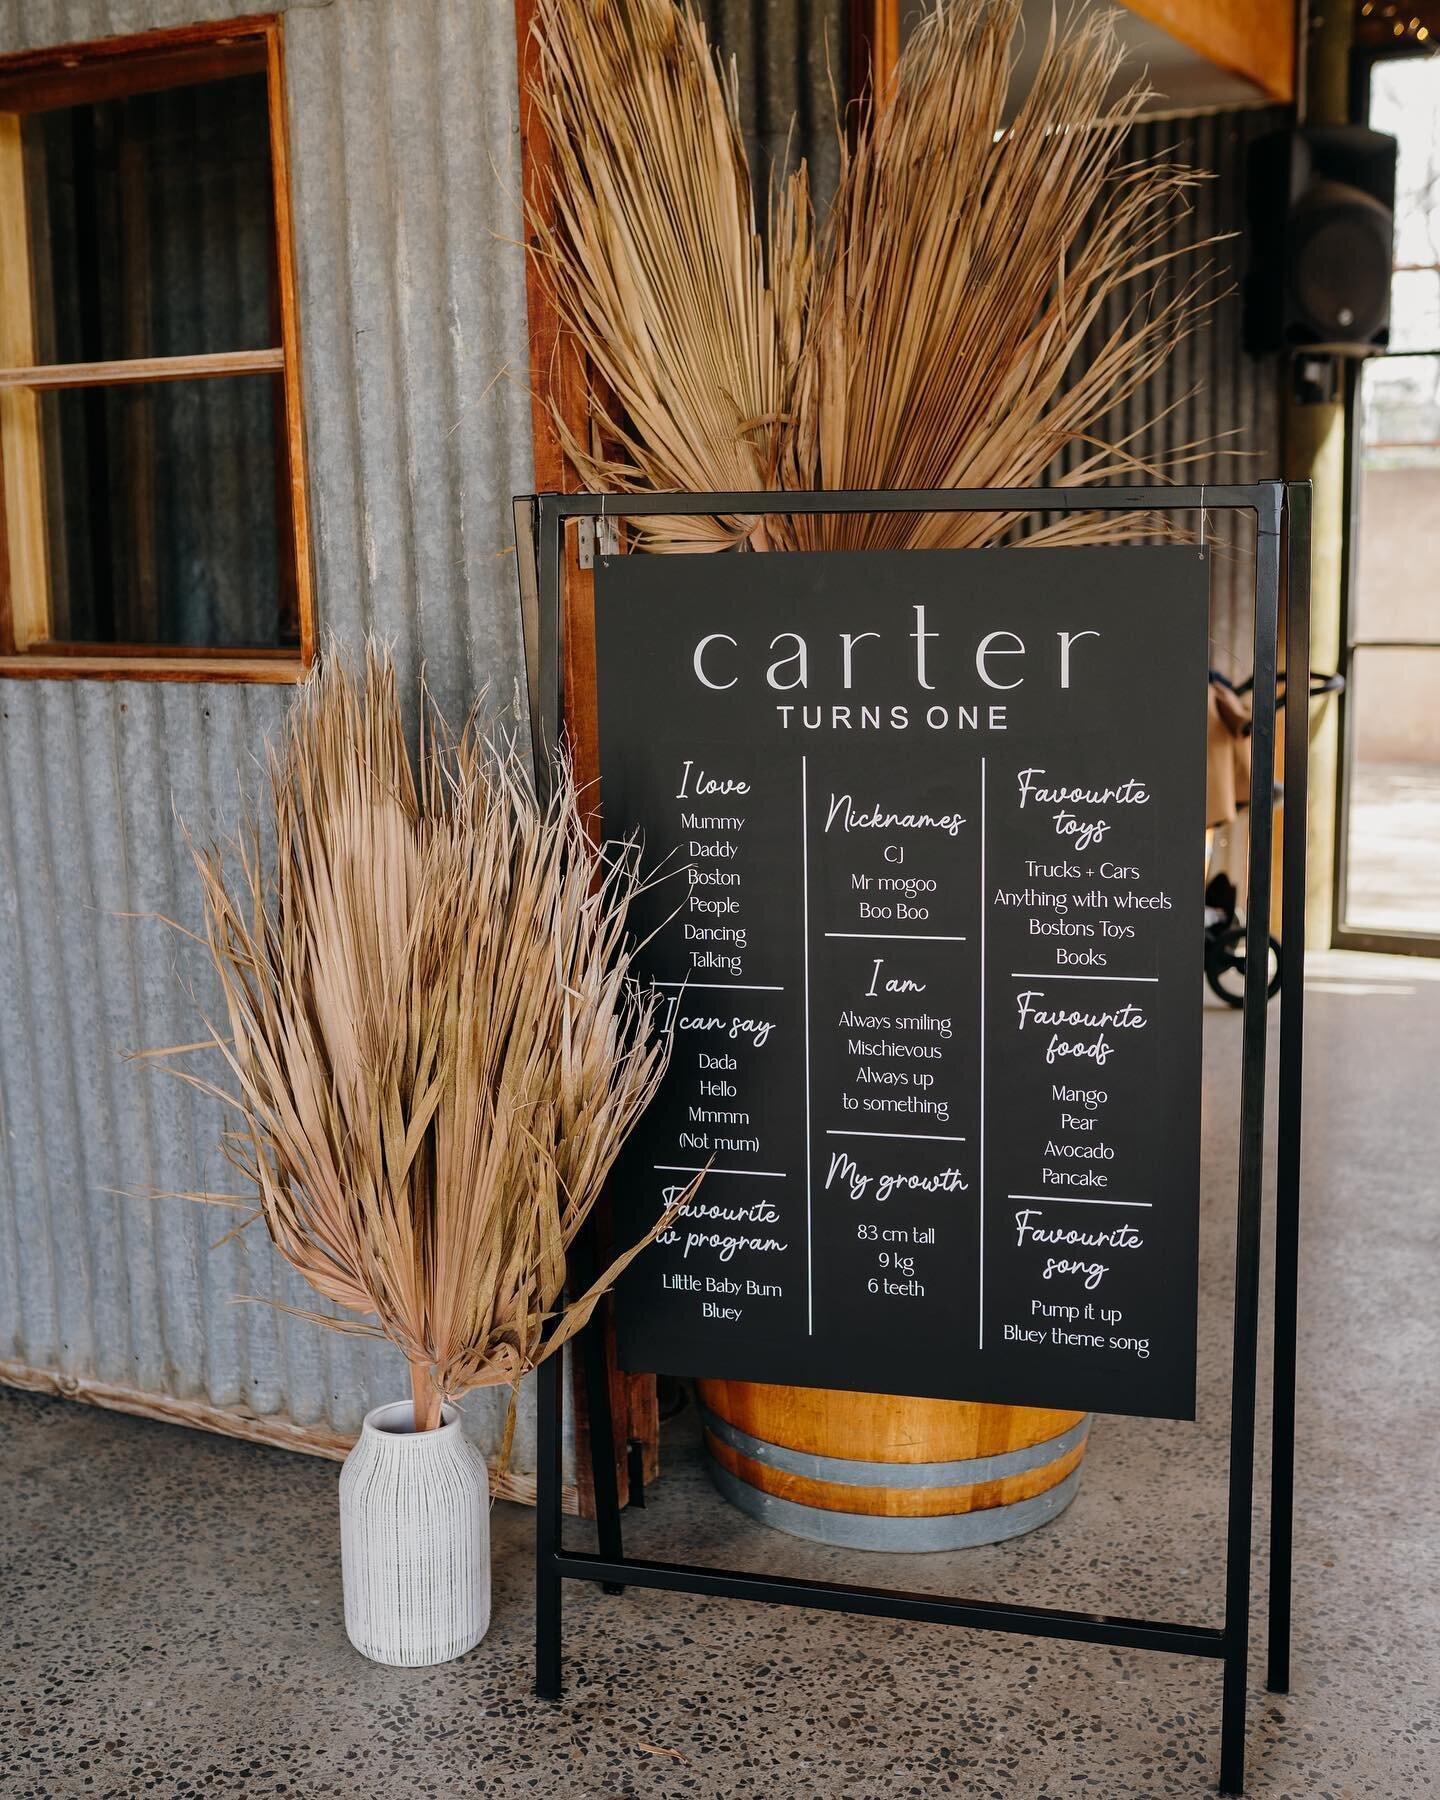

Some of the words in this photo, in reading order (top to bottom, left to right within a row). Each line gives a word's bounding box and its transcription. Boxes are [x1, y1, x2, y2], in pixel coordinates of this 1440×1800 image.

[693, 604, 1101, 691] carter
[777, 705, 909, 731] TURNS
[926, 705, 1009, 731] ONE
[675, 760, 693, 799] I
[696, 770, 750, 795] love
[1017, 767, 1150, 809] Favourite
[680, 813, 746, 832] Mummy
[824, 792, 967, 837] Nicknames
[1053, 809, 1112, 851] toys
[689, 841, 738, 859] Daddy
[884, 845, 904, 865] CJ
[687, 868, 741, 886] Boston
[1025, 860, 1081, 878] Trucks
[1086, 868, 1095, 878] +
[1100, 862, 1140, 880] Cars
[851, 873, 873, 890] Mr
[878, 878, 937, 899] mogoo
[689, 896, 740, 918] People
[860, 902, 892, 919] Boo
[897, 903, 929, 920] Boo
[994, 889, 1068, 915] Anything
[1072, 890, 1108, 908] with
[1114, 891, 1172, 910] wheels
[684, 924, 747, 949] Dancing
[1029, 918, 1095, 937] Bostons
[1099, 920, 1135, 940] Toys
[689, 951, 743, 976] Talking
[1056, 948, 1108, 966] Books
[865, 959, 884, 997] I
[885, 979, 927, 993] am
[660, 996, 678, 1034] I
[680, 1016, 727, 1031] can
[728, 1017, 777, 1048] say
[1016, 990, 1148, 1031] Favourite
[838, 1010, 890, 1030] Always
[895, 1013, 953, 1039] smiling
[848, 1039, 943, 1059] Mischievous
[1045, 1033, 1115, 1066] foods
[698, 1053, 737, 1071] Dada
[700, 1080, 737, 1097] Hello
[856, 1066, 908, 1086] Always
[913, 1073, 934, 1091] up
[843, 1092, 858, 1110] to
[863, 1096, 950, 1122] something
[1052, 1085, 1108, 1111] Mango
[689, 1106, 750, 1125] Mmmm
[1061, 1113, 1098, 1131] Pear
[679, 1132, 710, 1150] (Not
[715, 1136, 760, 1153] mum)
[1043, 1141, 1115, 1160] Avocado
[824, 1151, 874, 1201] My
[875, 1167, 969, 1202] growth
[1042, 1167, 1108, 1188] Pancake
[662, 1185, 780, 1223] Favourite
[857, 1224, 878, 1241] 83
[882, 1229, 908, 1243] cm
[912, 1227, 935, 1245] tall
[1014, 1208, 1144, 1249] Favourite
[684, 1232, 788, 1262] program
[878, 1252, 889, 1268] 9
[894, 1253, 915, 1277] kg
[1042, 1258, 1110, 1290] song
[662, 1273, 702, 1291] Lilttle
[705, 1277, 742, 1295] Baby
[746, 1280, 782, 1297] Bum
[867, 1278, 879, 1293] 6
[884, 1278, 925, 1297] teeth
[702, 1302, 743, 1322] Bluey
[1031, 1299, 1080, 1322] Pump
[1084, 1303, 1096, 1320] it
[1100, 1309, 1122, 1327] up
[1004, 1324, 1047, 1344] Bluey
[1052, 1328, 1105, 1348] theme
[1109, 1336, 1150, 1359] song
